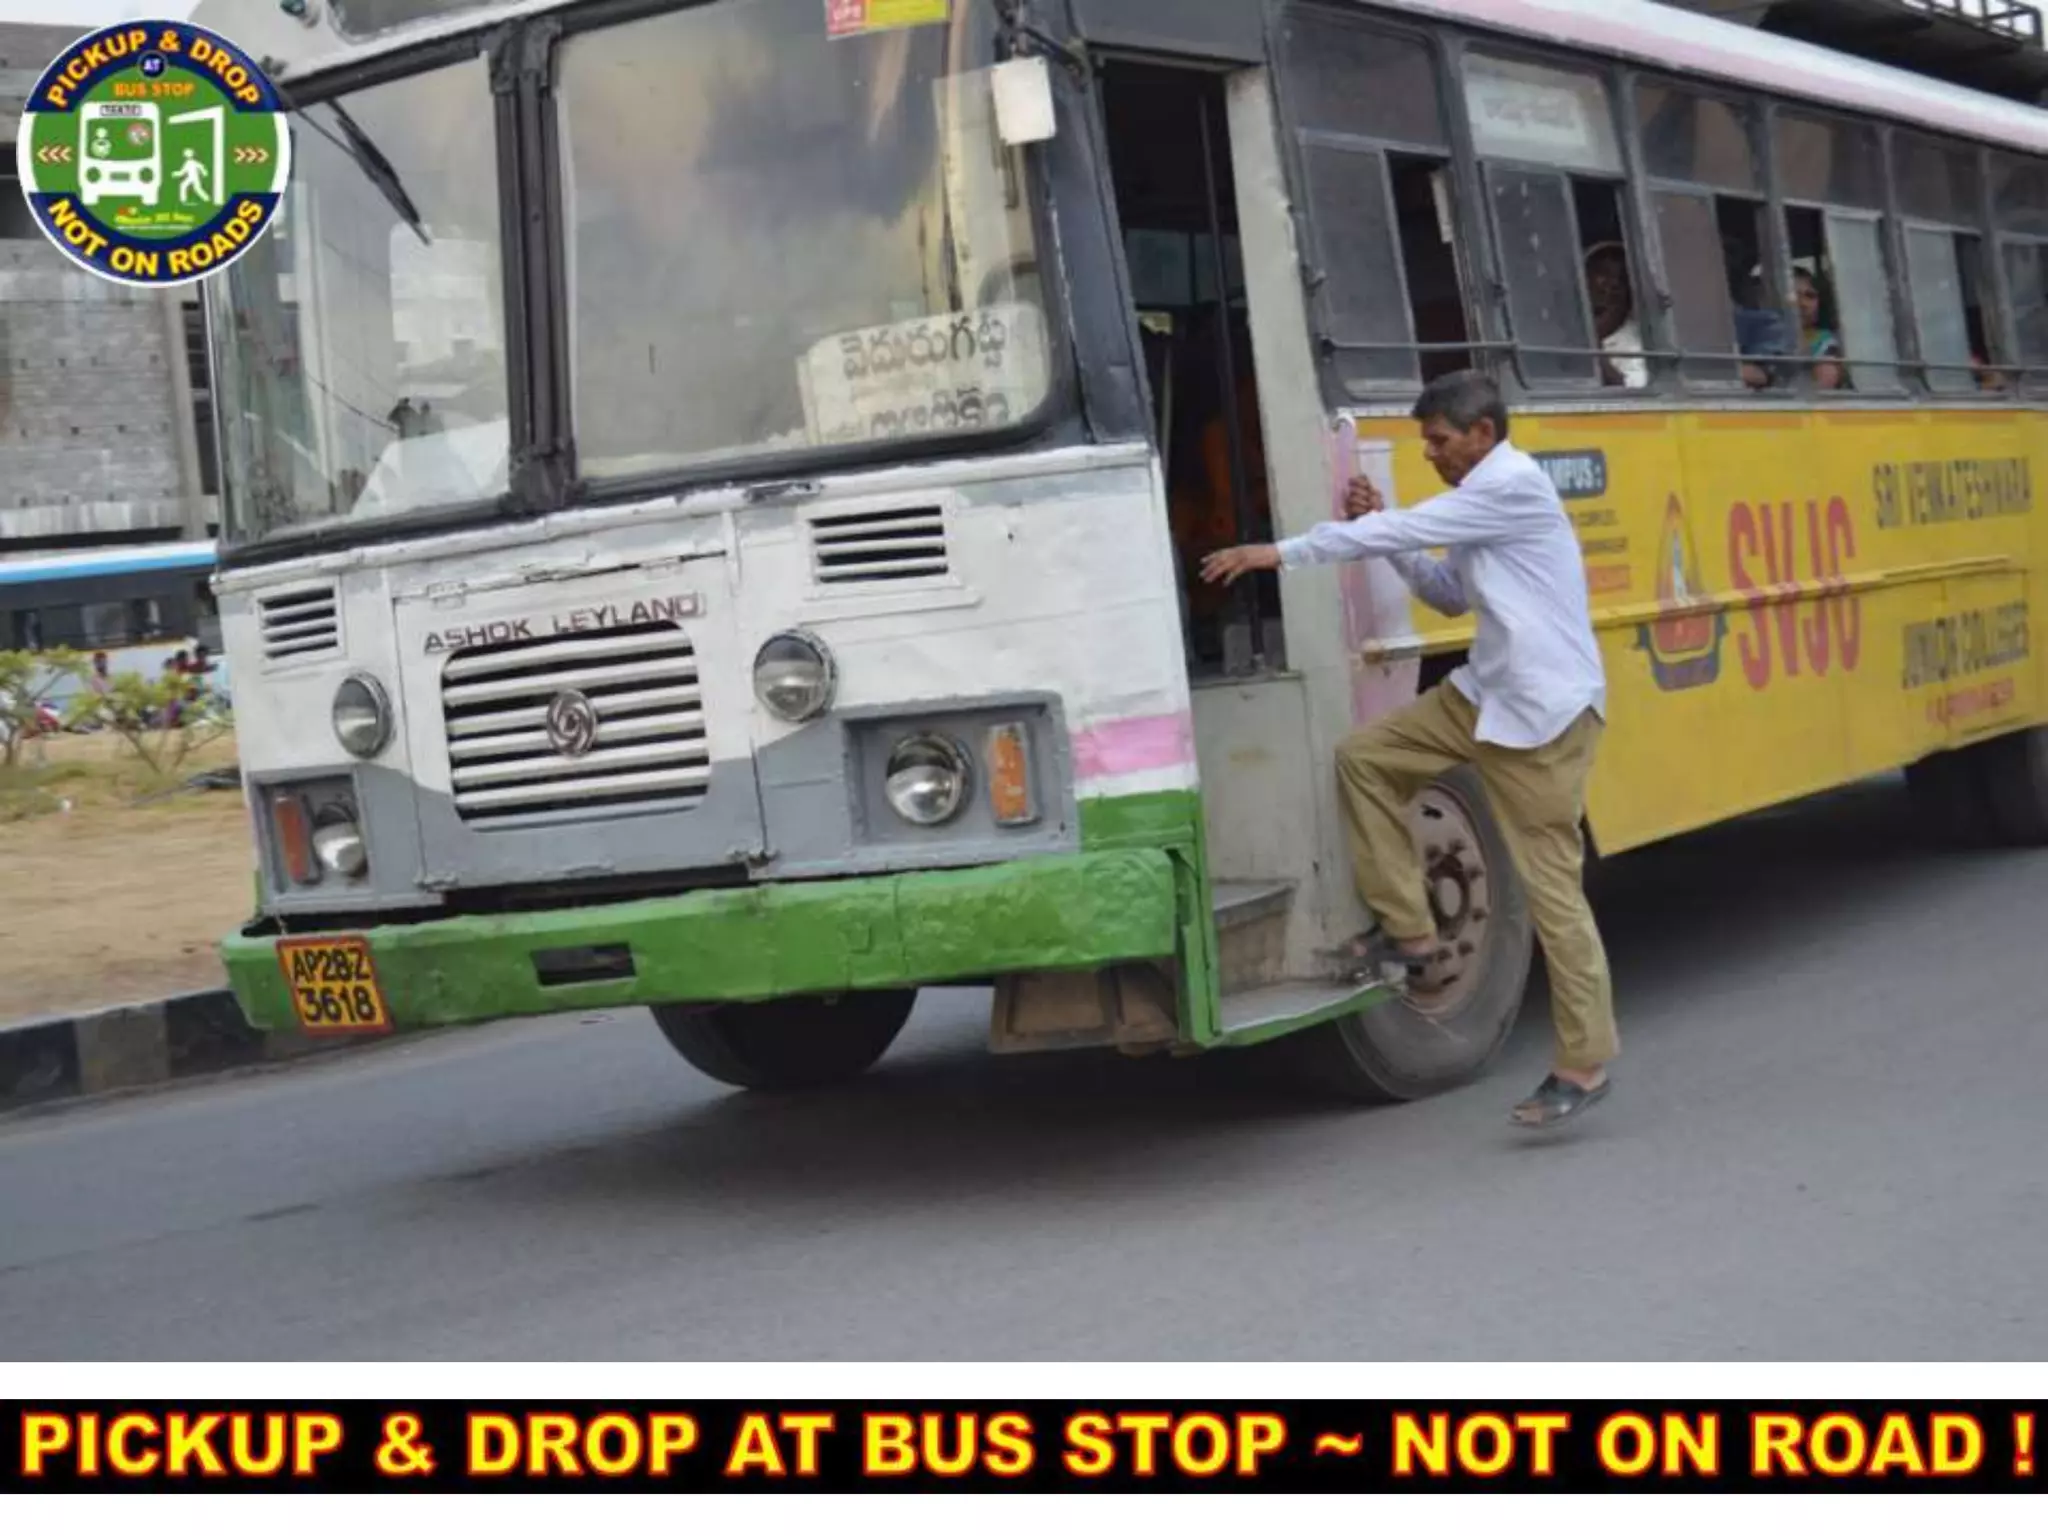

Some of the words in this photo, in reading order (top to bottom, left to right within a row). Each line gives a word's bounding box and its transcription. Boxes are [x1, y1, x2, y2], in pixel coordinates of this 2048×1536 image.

[1873, 463, 1904, 528] SRI
[424, 617, 533, 655] ASHOK
[553, 593, 705, 634] LEYLAND
[1728, 496, 1860, 691] SVJC
[292, 947, 371, 982] AP28Z
[298, 985, 376, 1023] 3618
